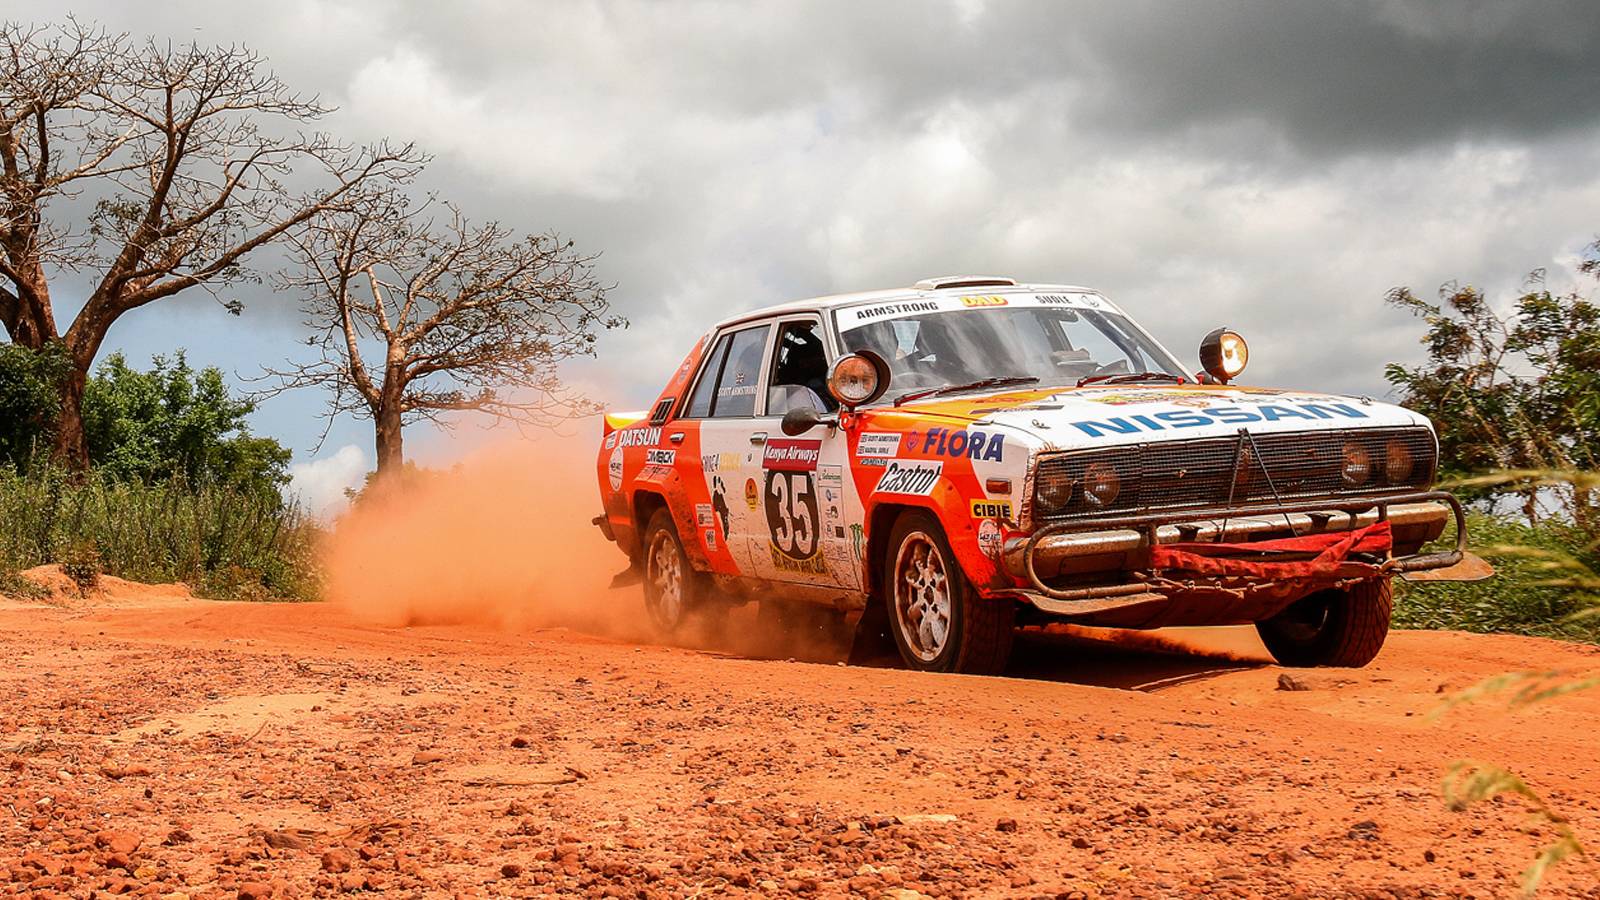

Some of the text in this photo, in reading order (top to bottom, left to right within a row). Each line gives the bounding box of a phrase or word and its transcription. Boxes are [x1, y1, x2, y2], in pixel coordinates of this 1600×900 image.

[856, 301, 939, 320] ARMSTRONG
[1070, 403, 1370, 438] NISSAN
[619, 427, 662, 447] DATSUN
[922, 427, 1005, 463] FLORA
[764, 445, 819, 464] Kenya Airways
[876, 462, 942, 494] Castrol
[771, 472, 814, 555] 35
[973, 503, 1011, 518] CIBIE
